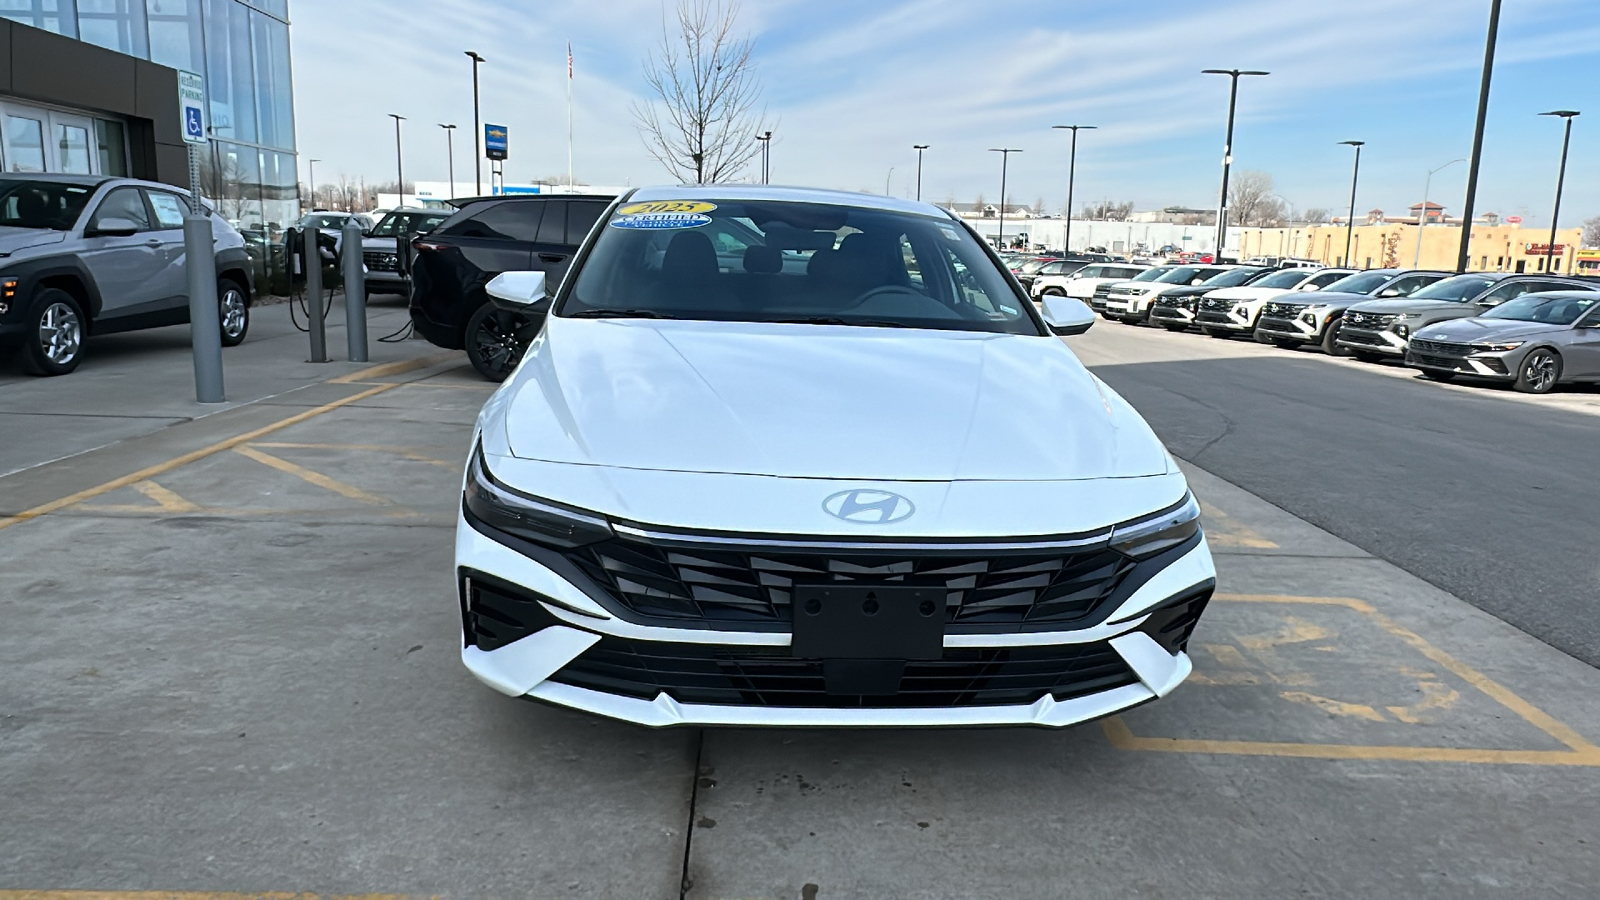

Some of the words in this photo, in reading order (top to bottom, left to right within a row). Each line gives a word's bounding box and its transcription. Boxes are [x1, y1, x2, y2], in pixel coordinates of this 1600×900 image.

[181, 87, 203, 102] PARKING
[632, 202, 701, 214] 2025
[622, 213, 701, 221] CERTIFIED
